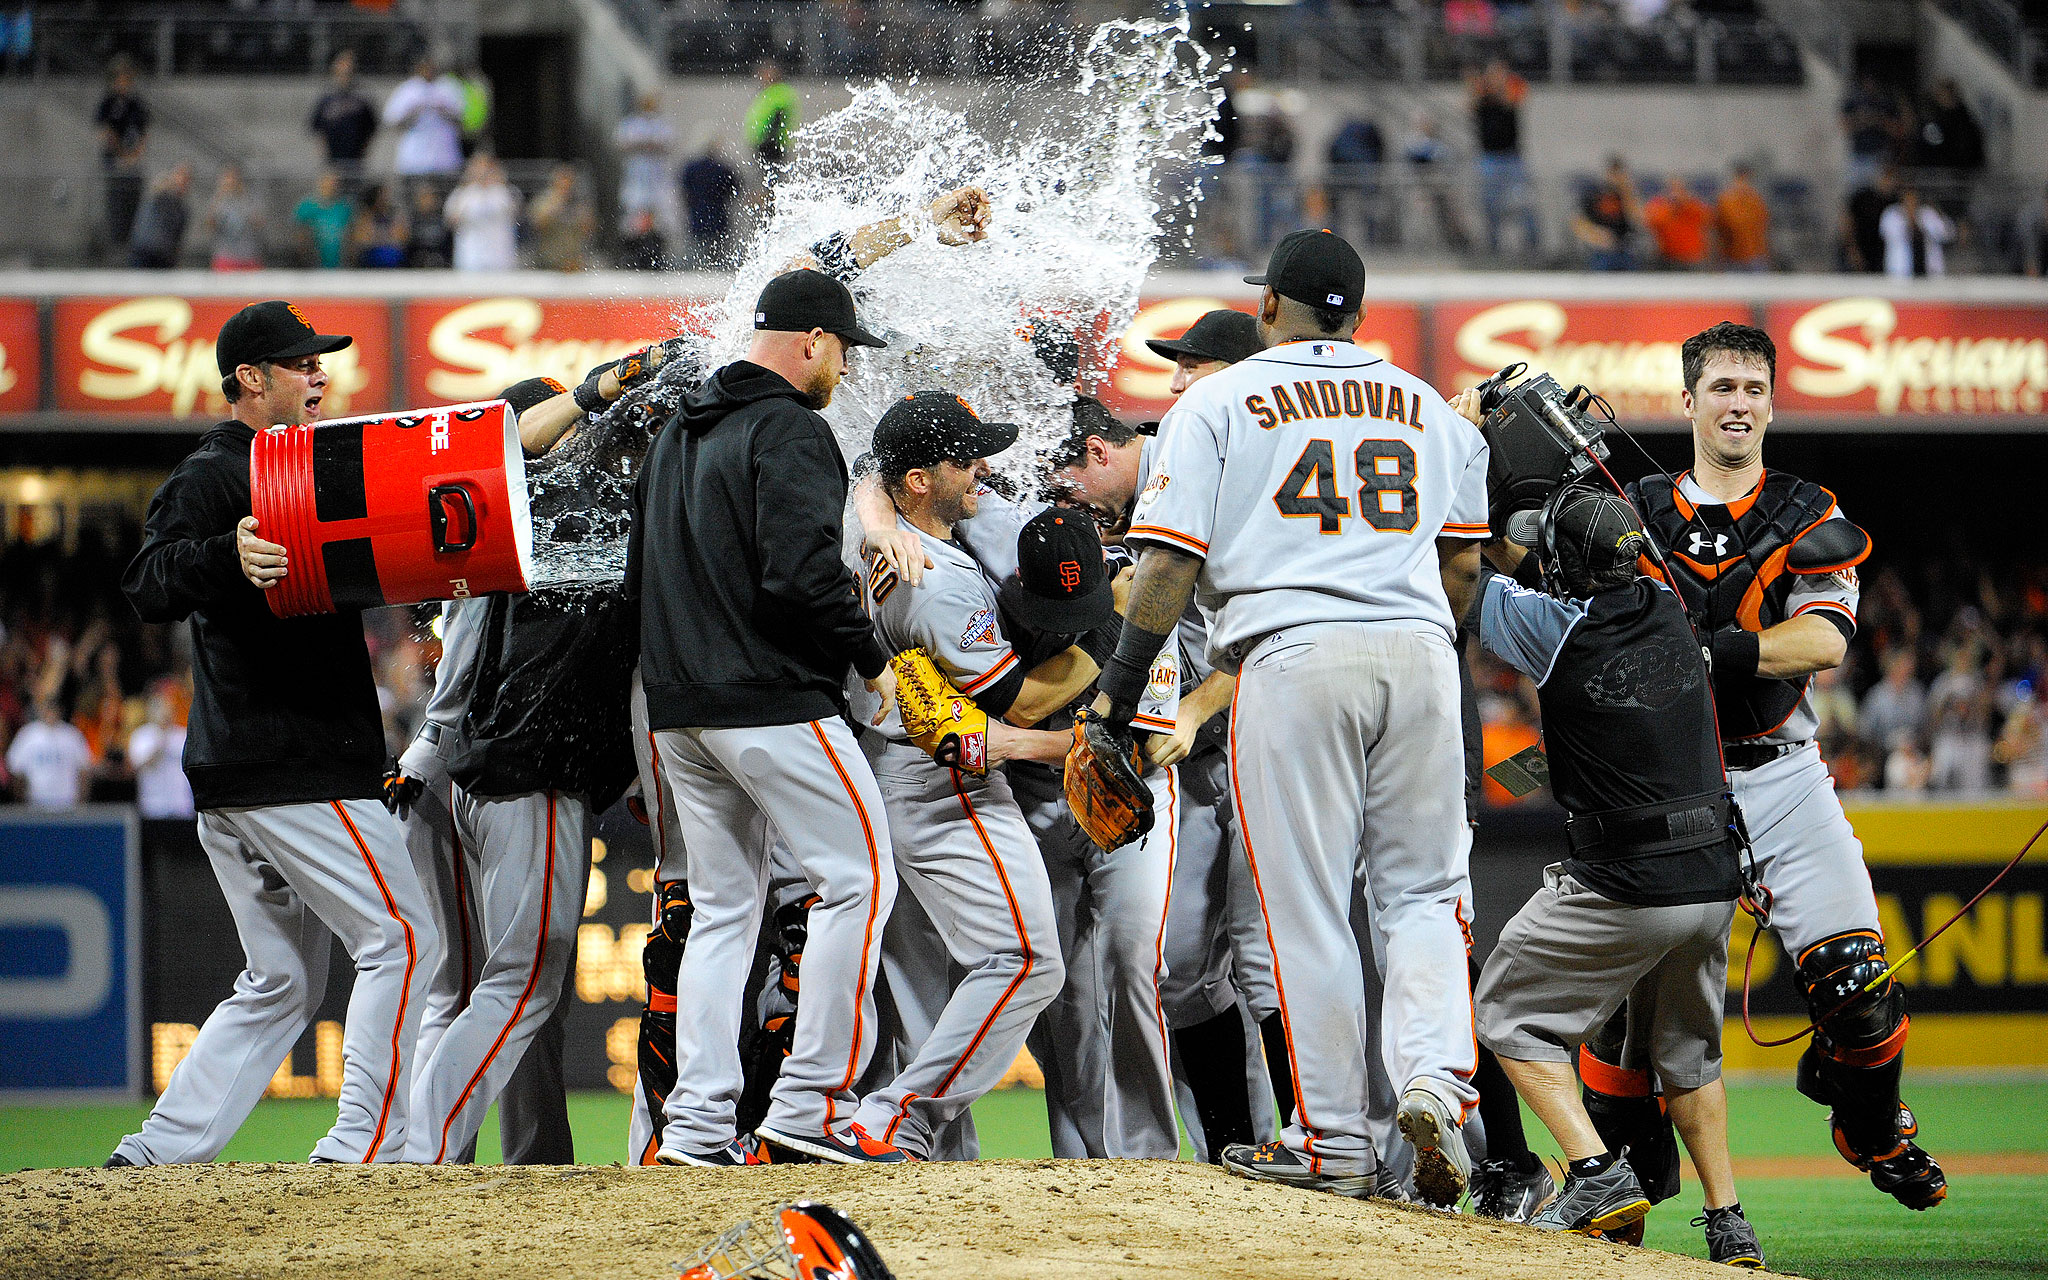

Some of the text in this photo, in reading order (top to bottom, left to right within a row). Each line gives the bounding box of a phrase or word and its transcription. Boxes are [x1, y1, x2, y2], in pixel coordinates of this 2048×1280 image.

[1245, 379, 1425, 433] SANDOVAL
[1272, 438, 1420, 536] 48
[1060, 560, 1081, 592] SF
[1150, 667, 1177, 687] IANT
